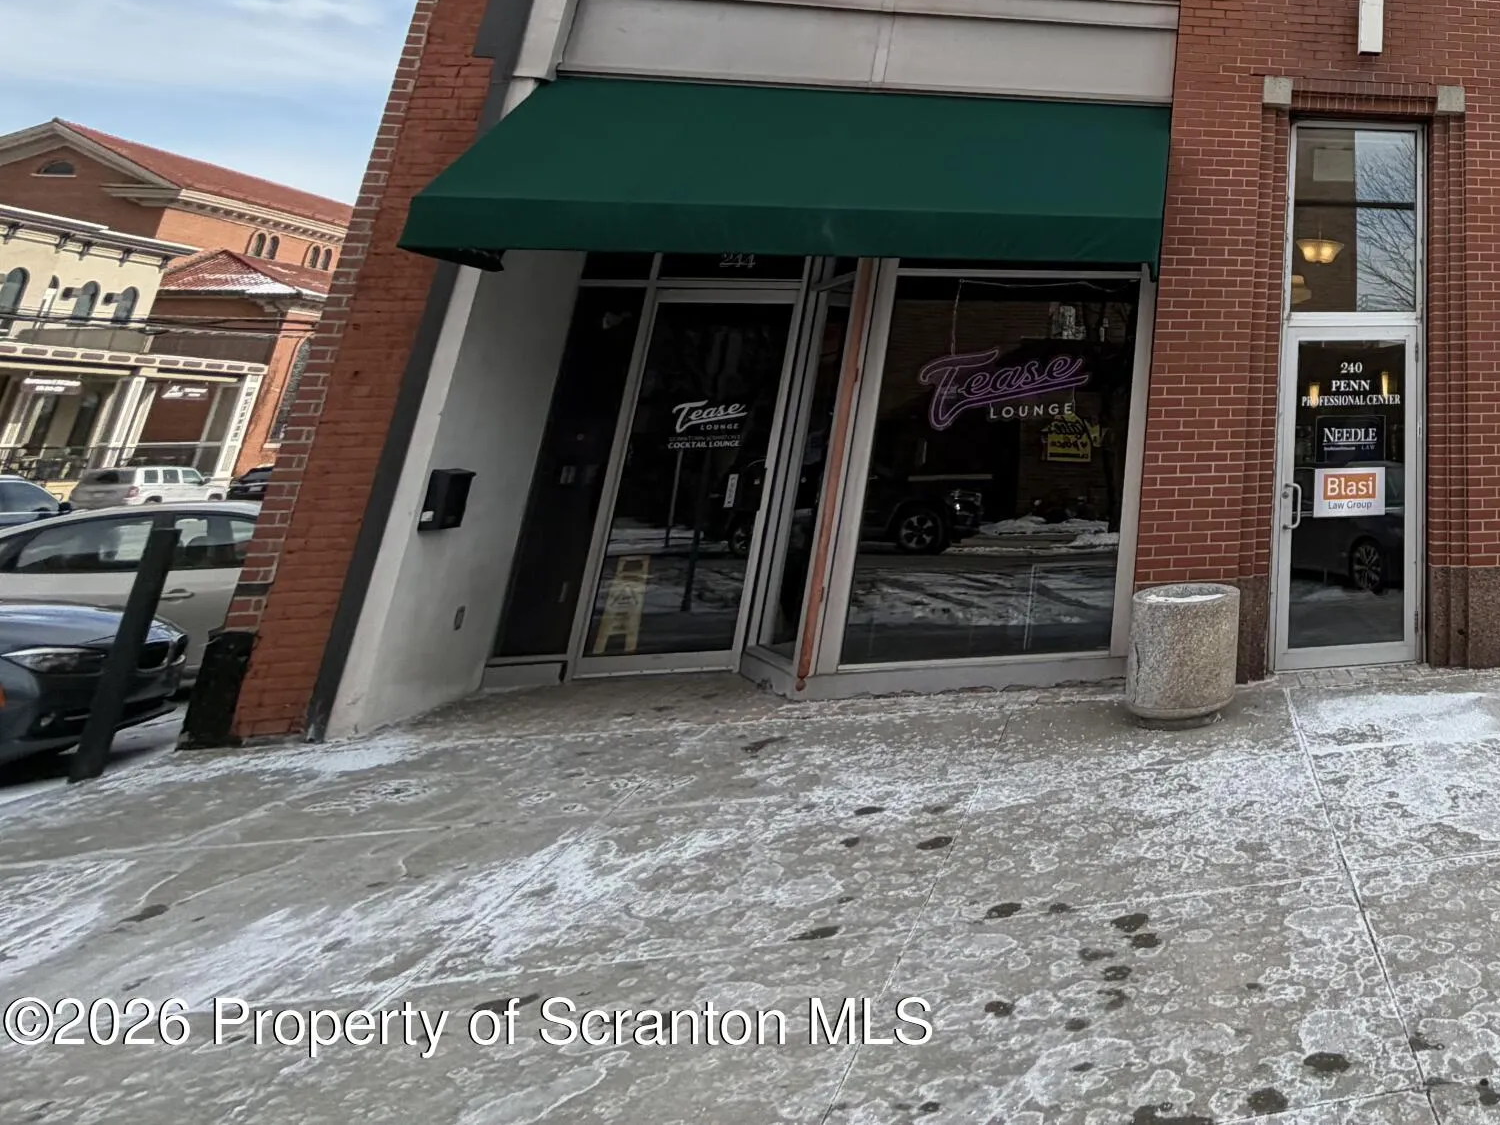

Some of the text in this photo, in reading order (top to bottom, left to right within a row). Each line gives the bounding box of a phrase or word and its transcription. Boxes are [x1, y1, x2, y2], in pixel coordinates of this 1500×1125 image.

[1340, 362, 1362, 373] 240
[919, 346, 1090, 430] Tease
[1331, 380, 1370, 391] PENN
[1302, 393, 1401, 406] PROFESSIONAL CENTER
[672, 399, 748, 434] Tease
[990, 402, 1073, 419] LOUNGE
[700, 423, 739, 431] LOUNGE
[1323, 428, 1377, 442] NEEDLE
[667, 440, 740, 449] COCKTAIL LOUNGE
[1327, 477, 1373, 495] Blasi
[1328, 500, 1372, 510] Law Group
